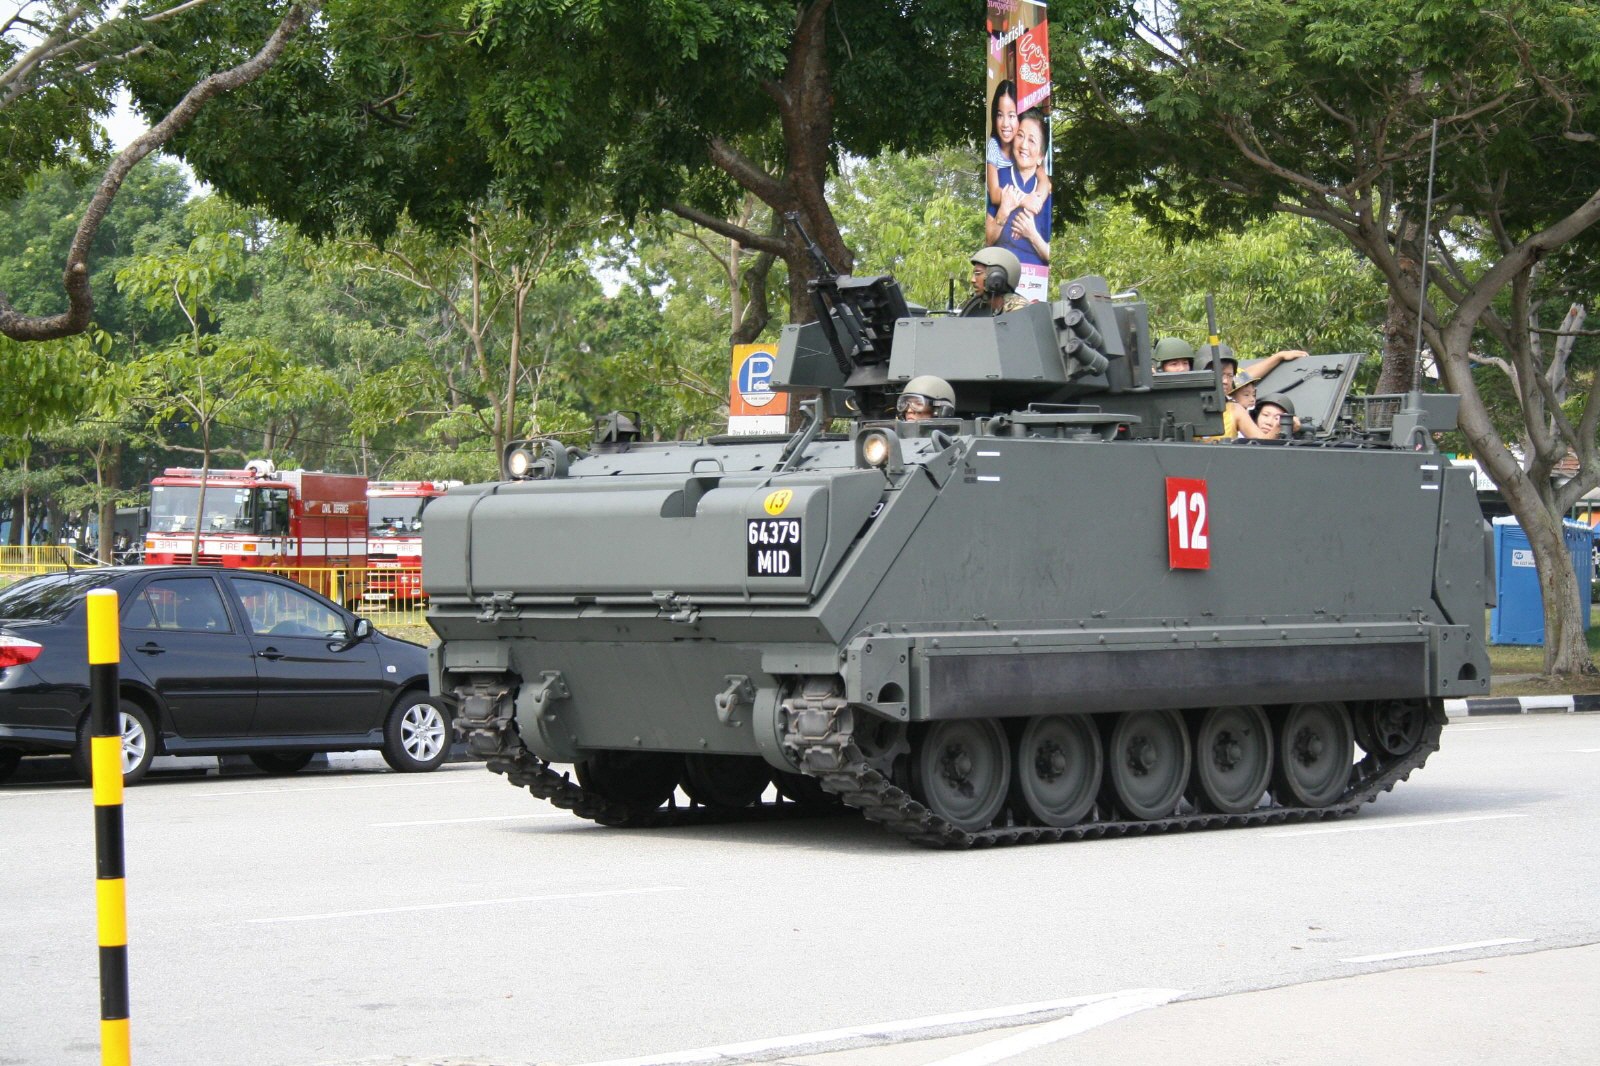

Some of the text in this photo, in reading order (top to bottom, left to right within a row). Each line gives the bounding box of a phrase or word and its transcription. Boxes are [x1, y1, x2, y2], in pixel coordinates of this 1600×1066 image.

[996, 20, 1024, 51] cherish
[747, 357, 773, 392] P
[769, 492, 789, 509] 13
[1170, 490, 1208, 549] 12
[749, 521, 800, 544] 64379
[219, 542, 240, 551] FIRE
[396, 544, 414, 552] FIRE
[757, 550, 790, 573] MID
